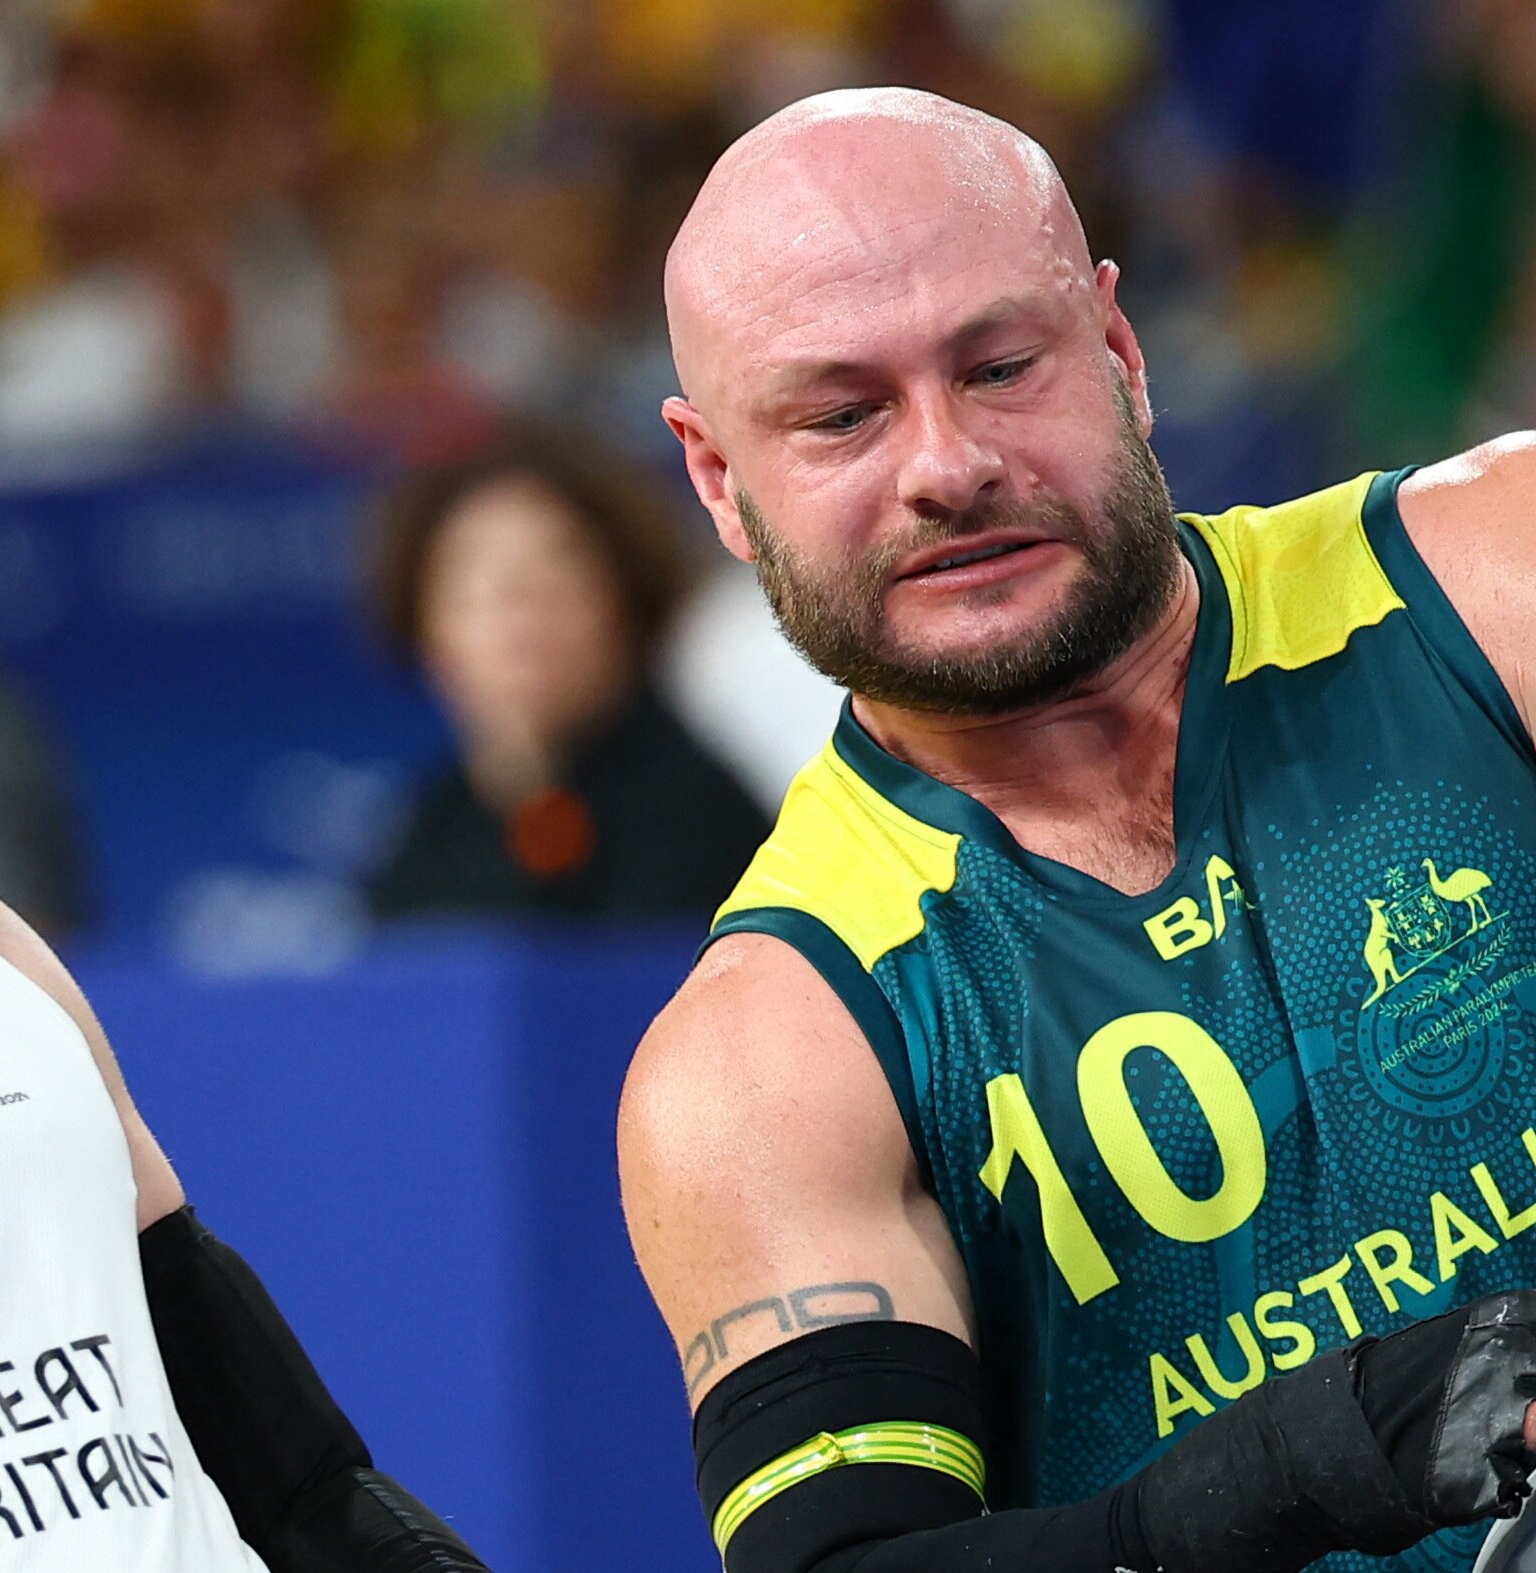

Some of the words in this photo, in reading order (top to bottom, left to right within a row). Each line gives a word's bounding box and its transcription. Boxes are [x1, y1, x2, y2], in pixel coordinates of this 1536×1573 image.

[1379, 1014, 1454, 1074] AUSTRALIAN
[1452, 971, 1521, 1023] PARALYMPIC
[1444, 1019, 1478, 1048] PARIS
[1478, 999, 1508, 1026] 2024
[978, 1011, 1267, 1305] 10
